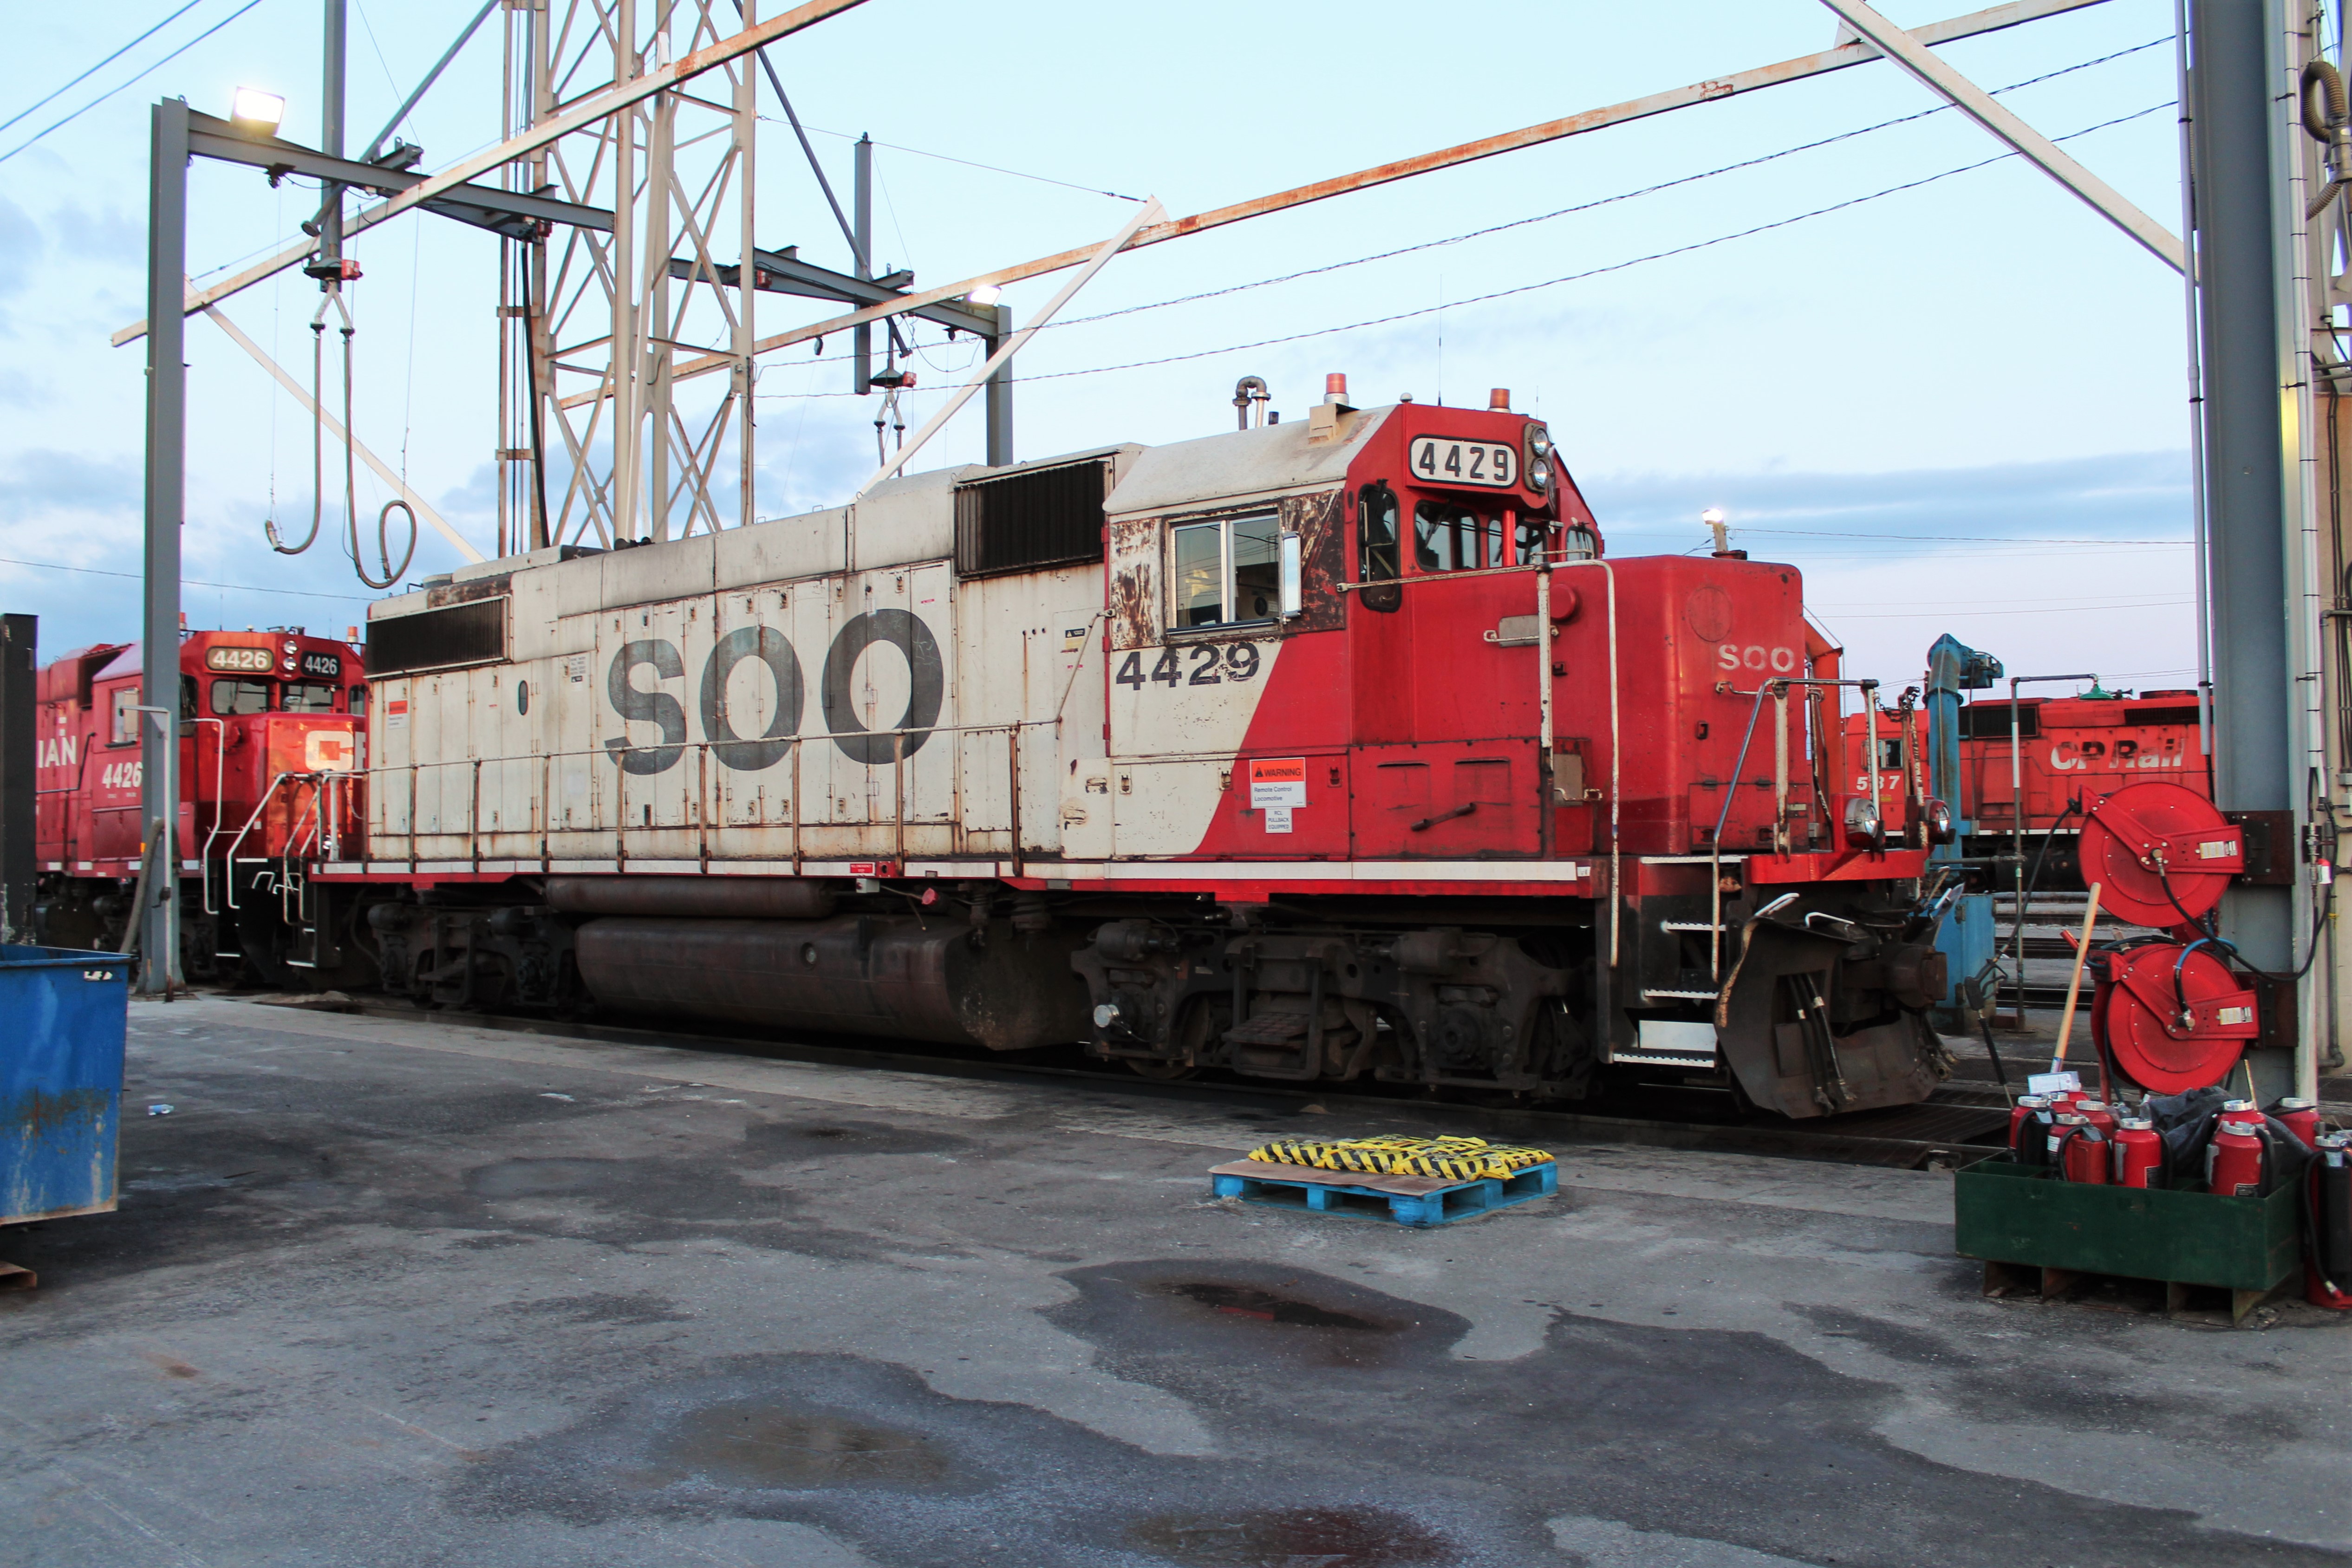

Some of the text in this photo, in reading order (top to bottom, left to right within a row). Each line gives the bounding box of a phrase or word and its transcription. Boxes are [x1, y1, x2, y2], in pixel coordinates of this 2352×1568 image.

[1419, 442, 1508, 481] 4429
[213, 651, 268, 669] 4426
[305, 656, 338, 675] 4426
[1116, 642, 1260, 691] 4429
[1718, 644, 1795, 673] SOO
[605, 608, 944, 775] SOO
[2050, 738, 2185, 770] CP Rail
[102, 761, 143, 789] 4426
[1264, 768, 1301, 777] WARNING
